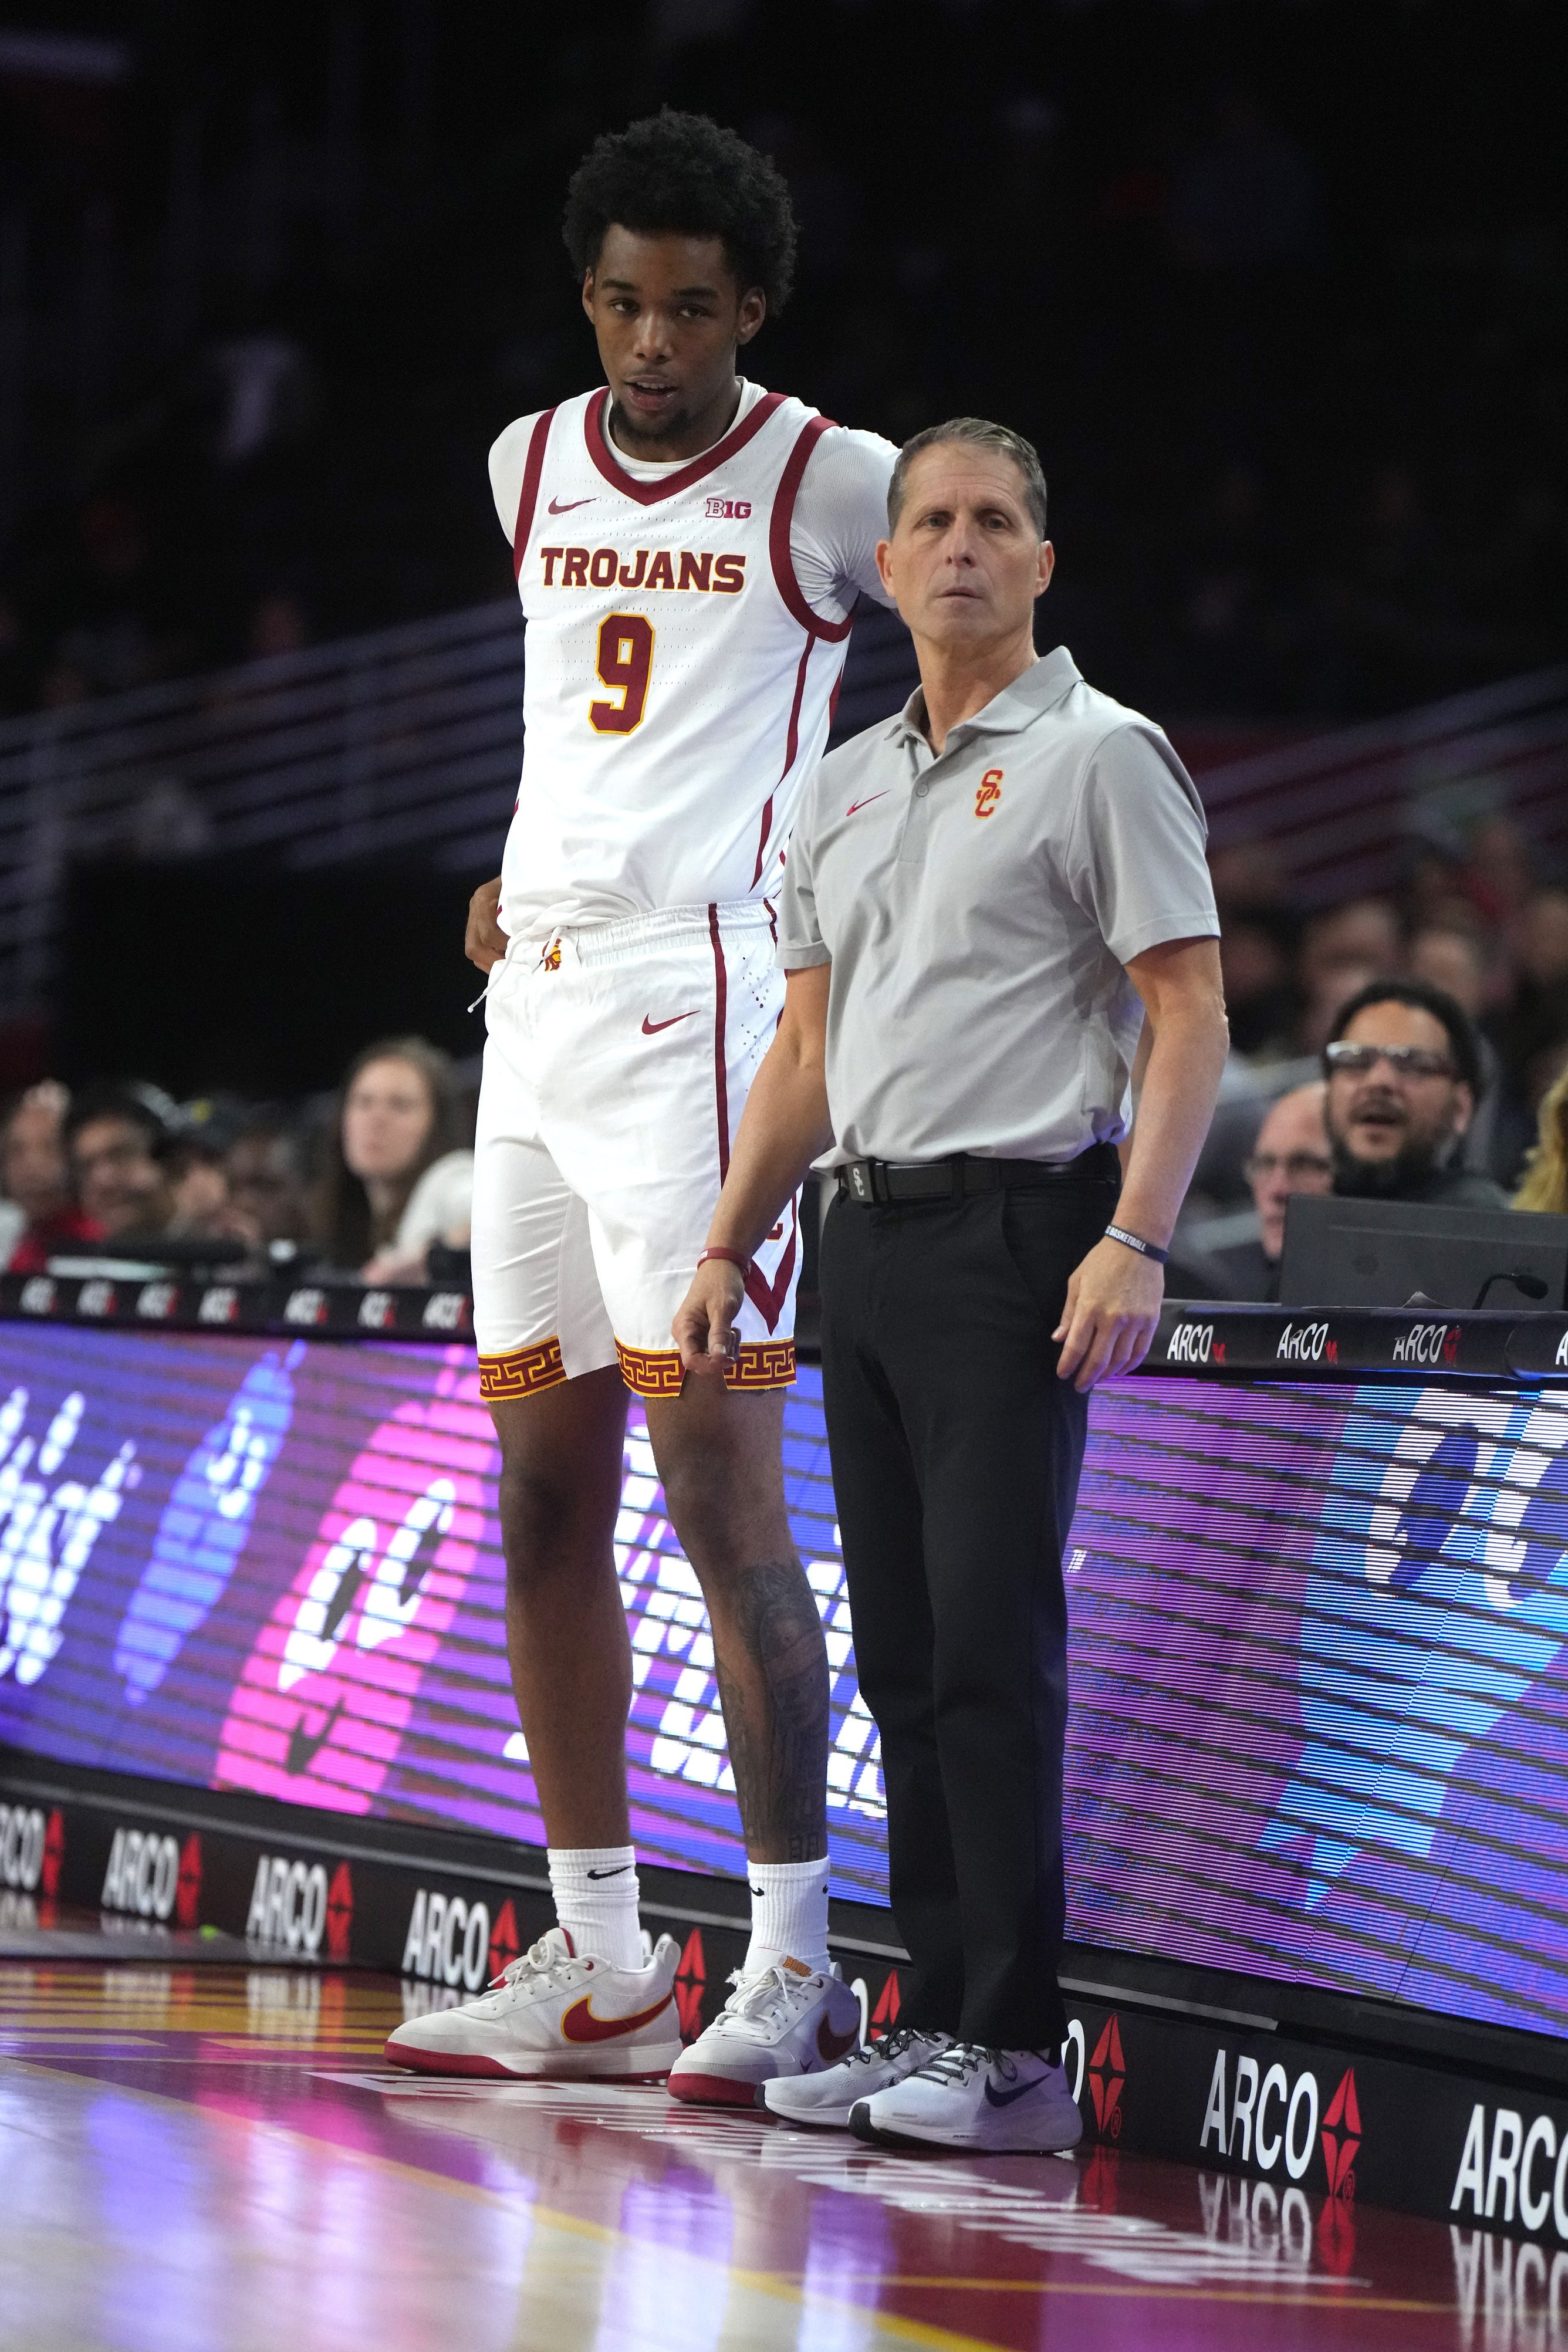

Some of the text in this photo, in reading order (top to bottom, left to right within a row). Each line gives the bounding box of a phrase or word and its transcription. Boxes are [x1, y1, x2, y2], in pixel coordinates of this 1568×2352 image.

[540, 547, 746, 595] TROJANS
[588, 613, 655, 735] 9
[1109, 1226, 1147, 1252] BASKETBALL
[1167, 1323, 1214, 1363] ARCO
[1276, 1322, 1329, 1361] ARCO
[1393, 1324, 1448, 1363] ARCO
[101, 1827, 179, 1920] ARCO
[245, 1854, 328, 1951] ARCO
[401, 1888, 490, 1992] ARCO
[1199, 2049, 1319, 2179] ARCO
